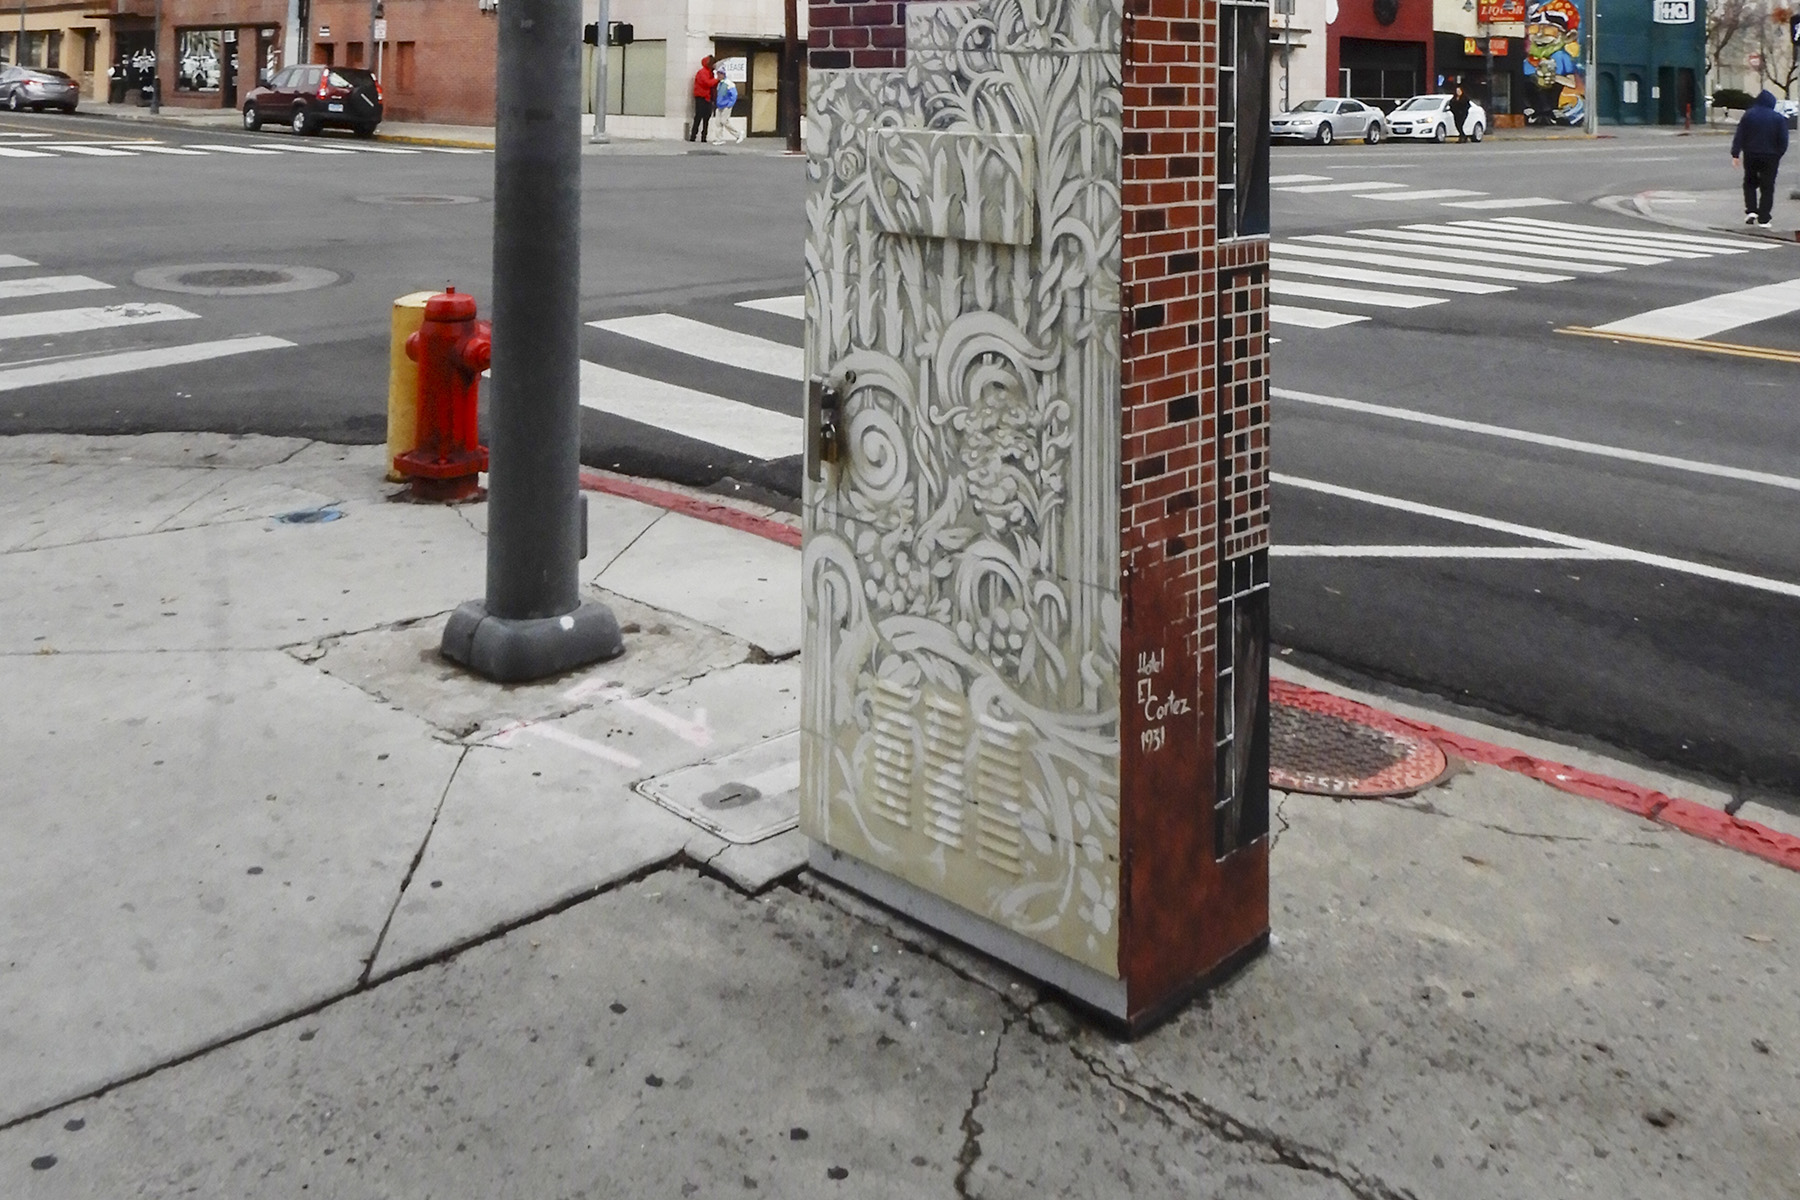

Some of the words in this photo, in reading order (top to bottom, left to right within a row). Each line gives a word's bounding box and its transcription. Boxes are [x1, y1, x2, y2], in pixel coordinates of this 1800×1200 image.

[1662, 2, 1688, 19] HQ
[1137, 647, 1165, 675] Hotel
[1144, 689, 1192, 721] Cortez
[1140, 725, 1166, 755] 1931
